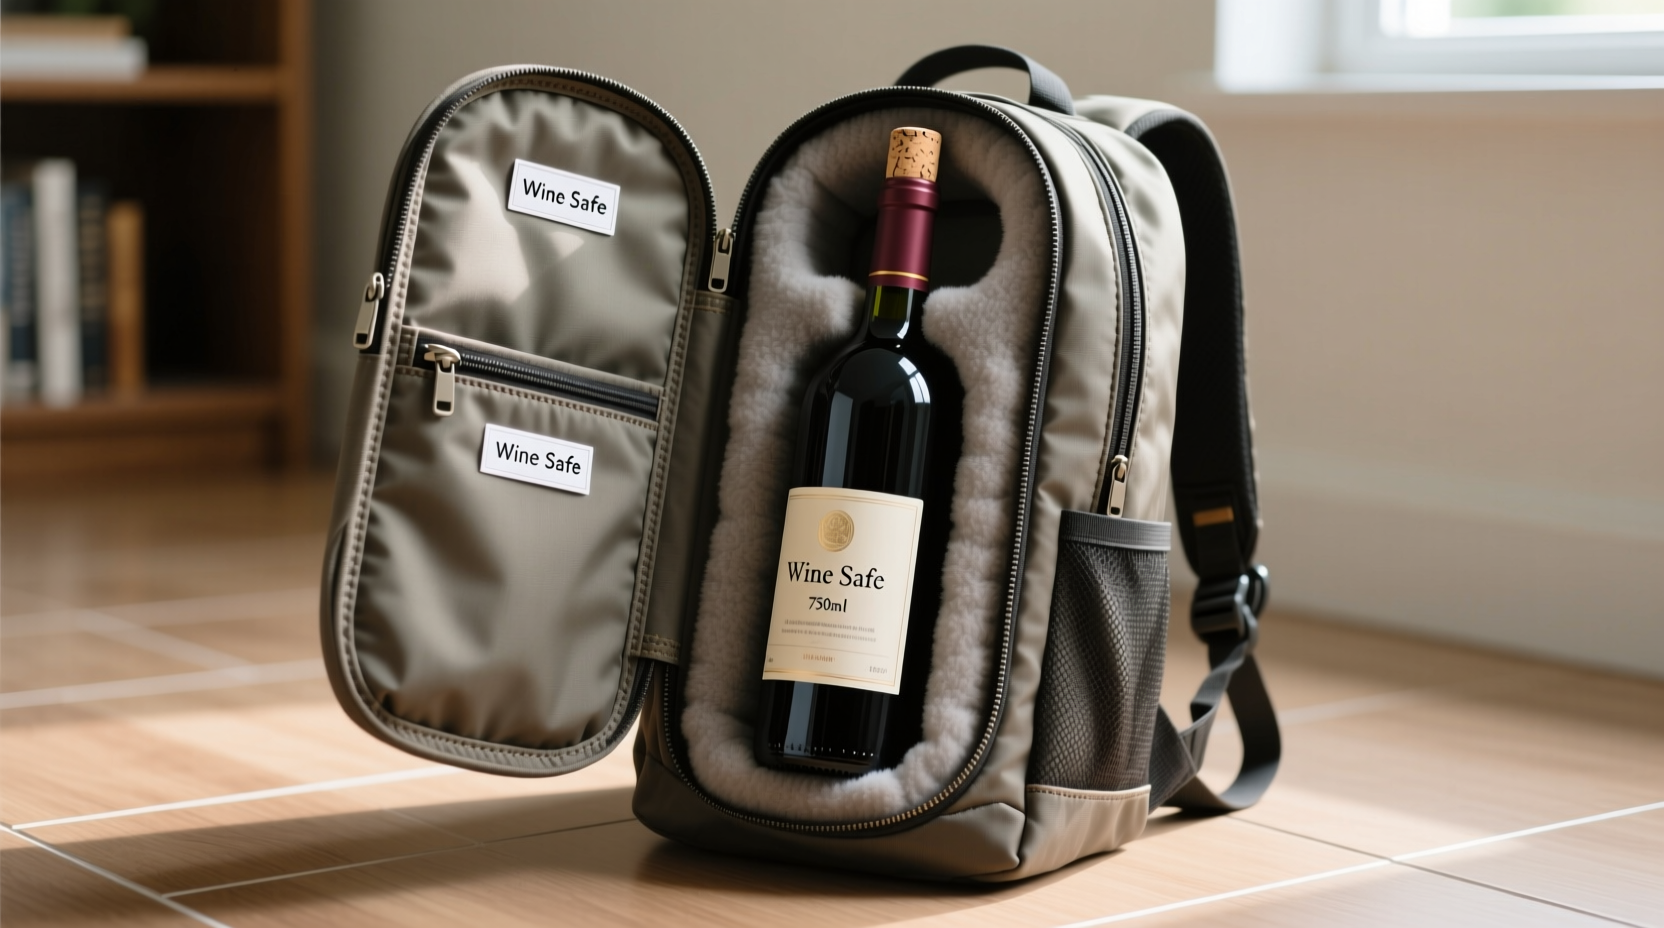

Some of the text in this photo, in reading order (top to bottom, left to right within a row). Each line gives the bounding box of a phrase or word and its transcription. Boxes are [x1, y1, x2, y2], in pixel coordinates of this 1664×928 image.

[523, 178, 607, 215] Wine Safe
[496, 441, 581, 475] Wine Safe
[788, 561, 885, 590] Wine Safe
[808, 596, 848, 613] 750ml
